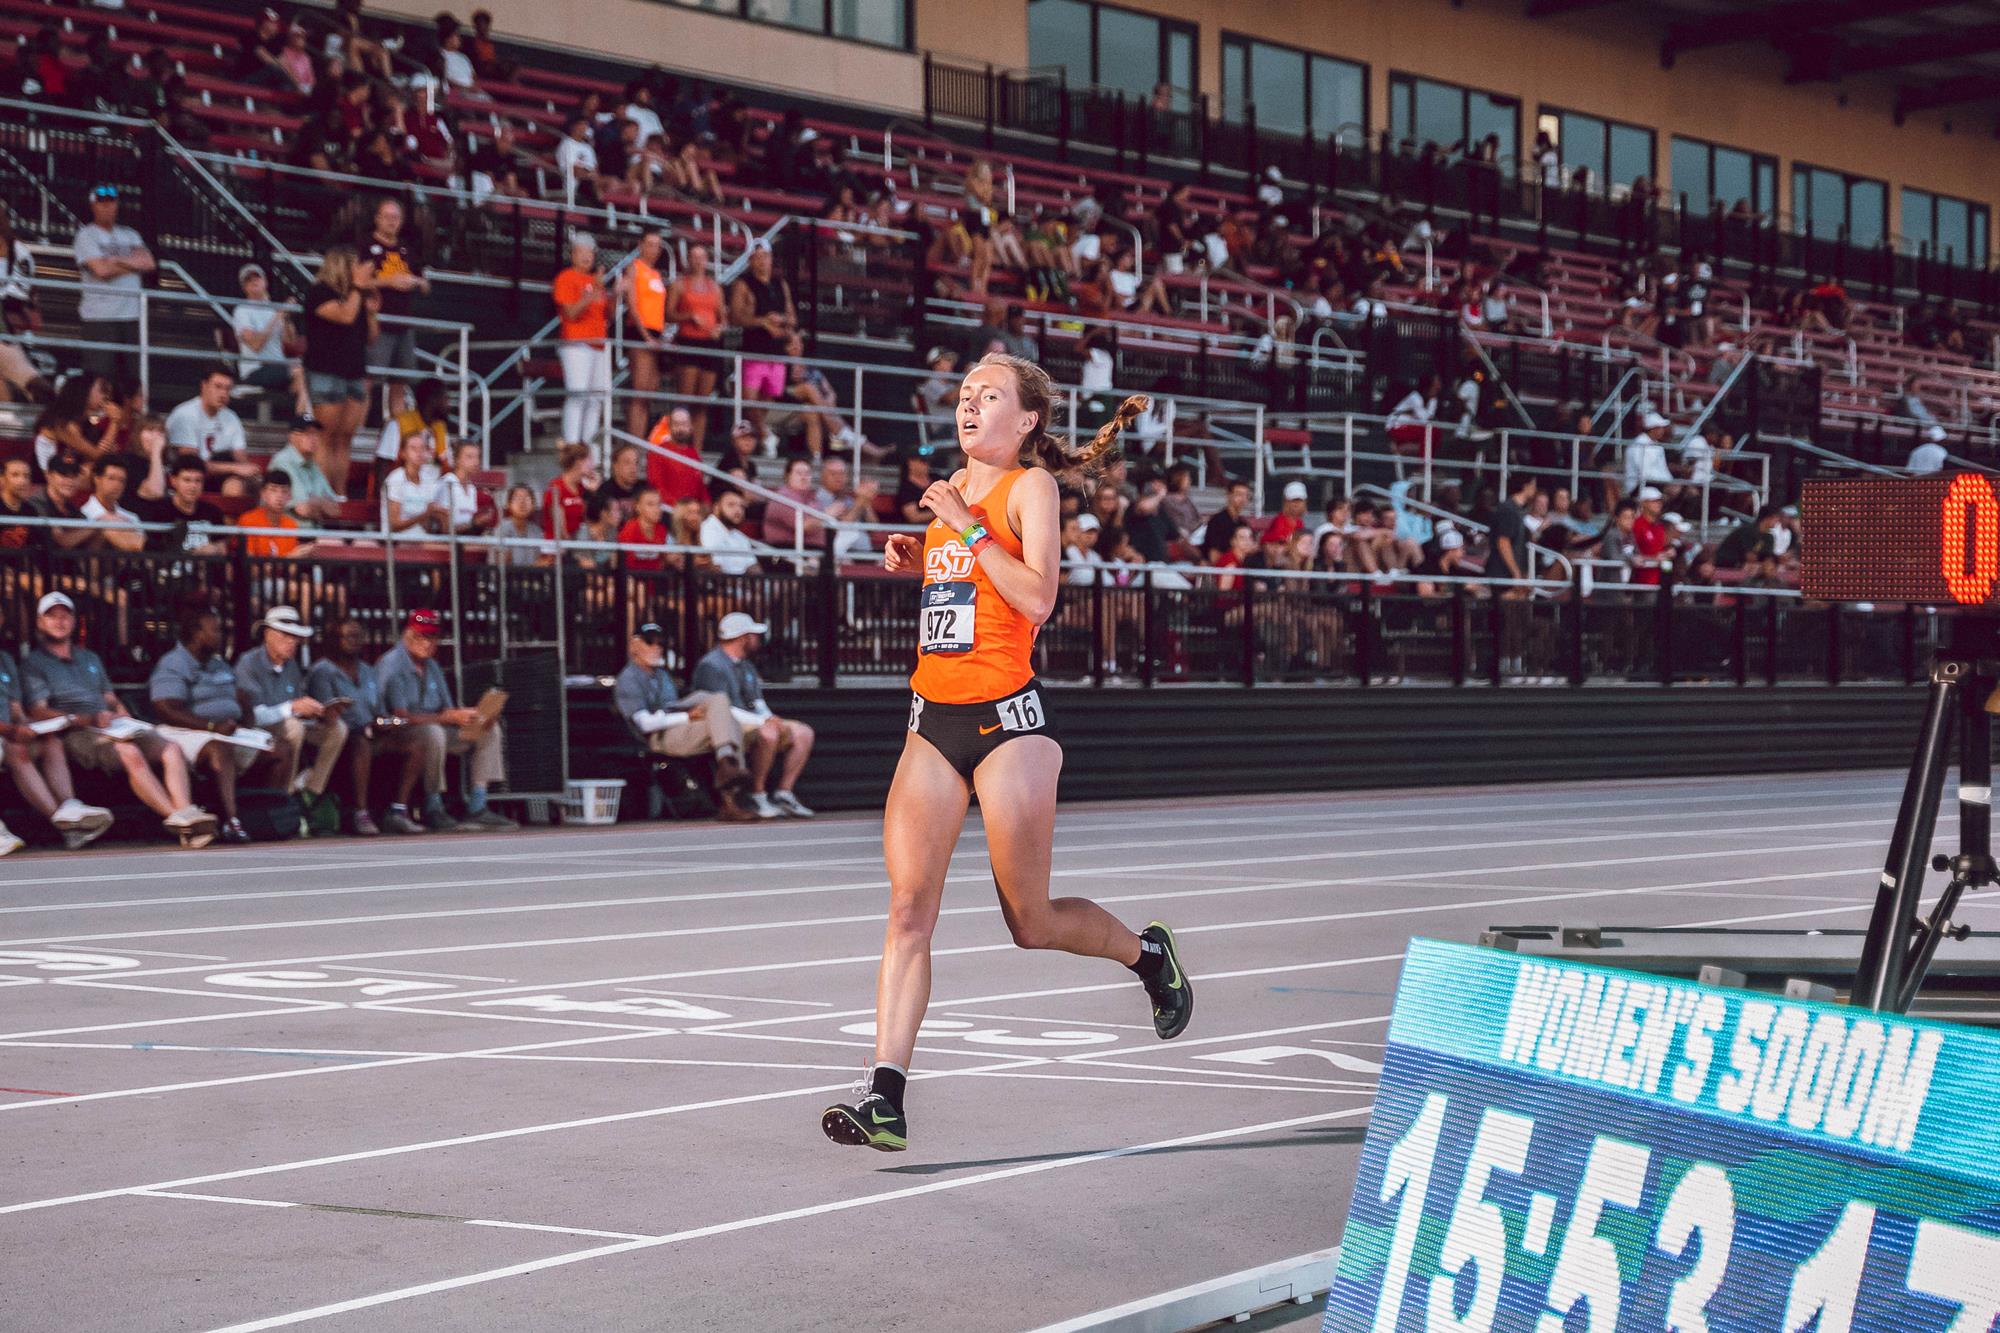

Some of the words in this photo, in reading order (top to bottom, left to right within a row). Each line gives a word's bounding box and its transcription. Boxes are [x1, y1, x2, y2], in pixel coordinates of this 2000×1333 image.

[926, 541, 975, 582] OSU
[927, 608, 957, 641] 972
[1007, 695, 1038, 727] 16
[1500, 963, 1726, 1102] WOMEN'S
[1716, 1002, 1943, 1151] 5000M
